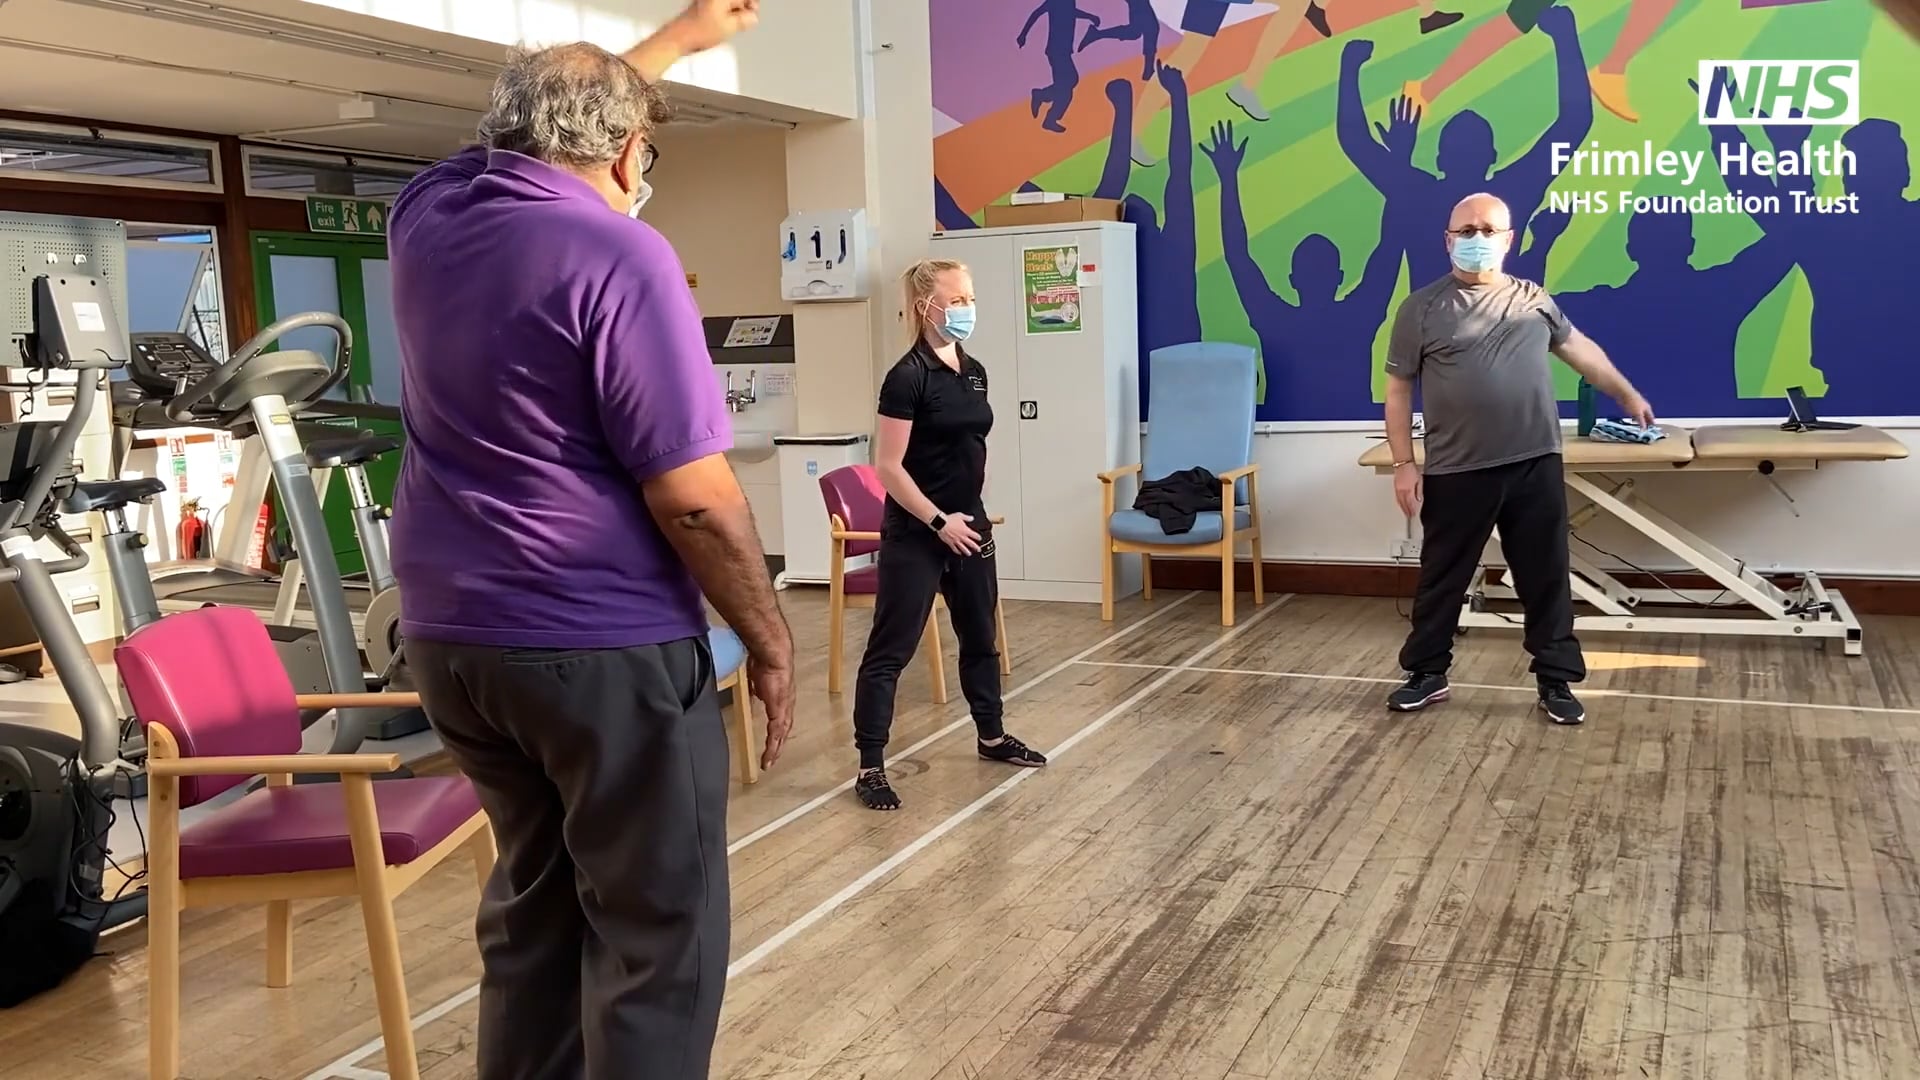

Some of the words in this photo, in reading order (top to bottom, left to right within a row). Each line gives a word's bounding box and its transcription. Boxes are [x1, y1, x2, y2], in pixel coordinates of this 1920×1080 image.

[315, 201, 334, 214] Fire
[317, 216, 336, 227] exit
[1025, 251, 1057, 262] Happy
